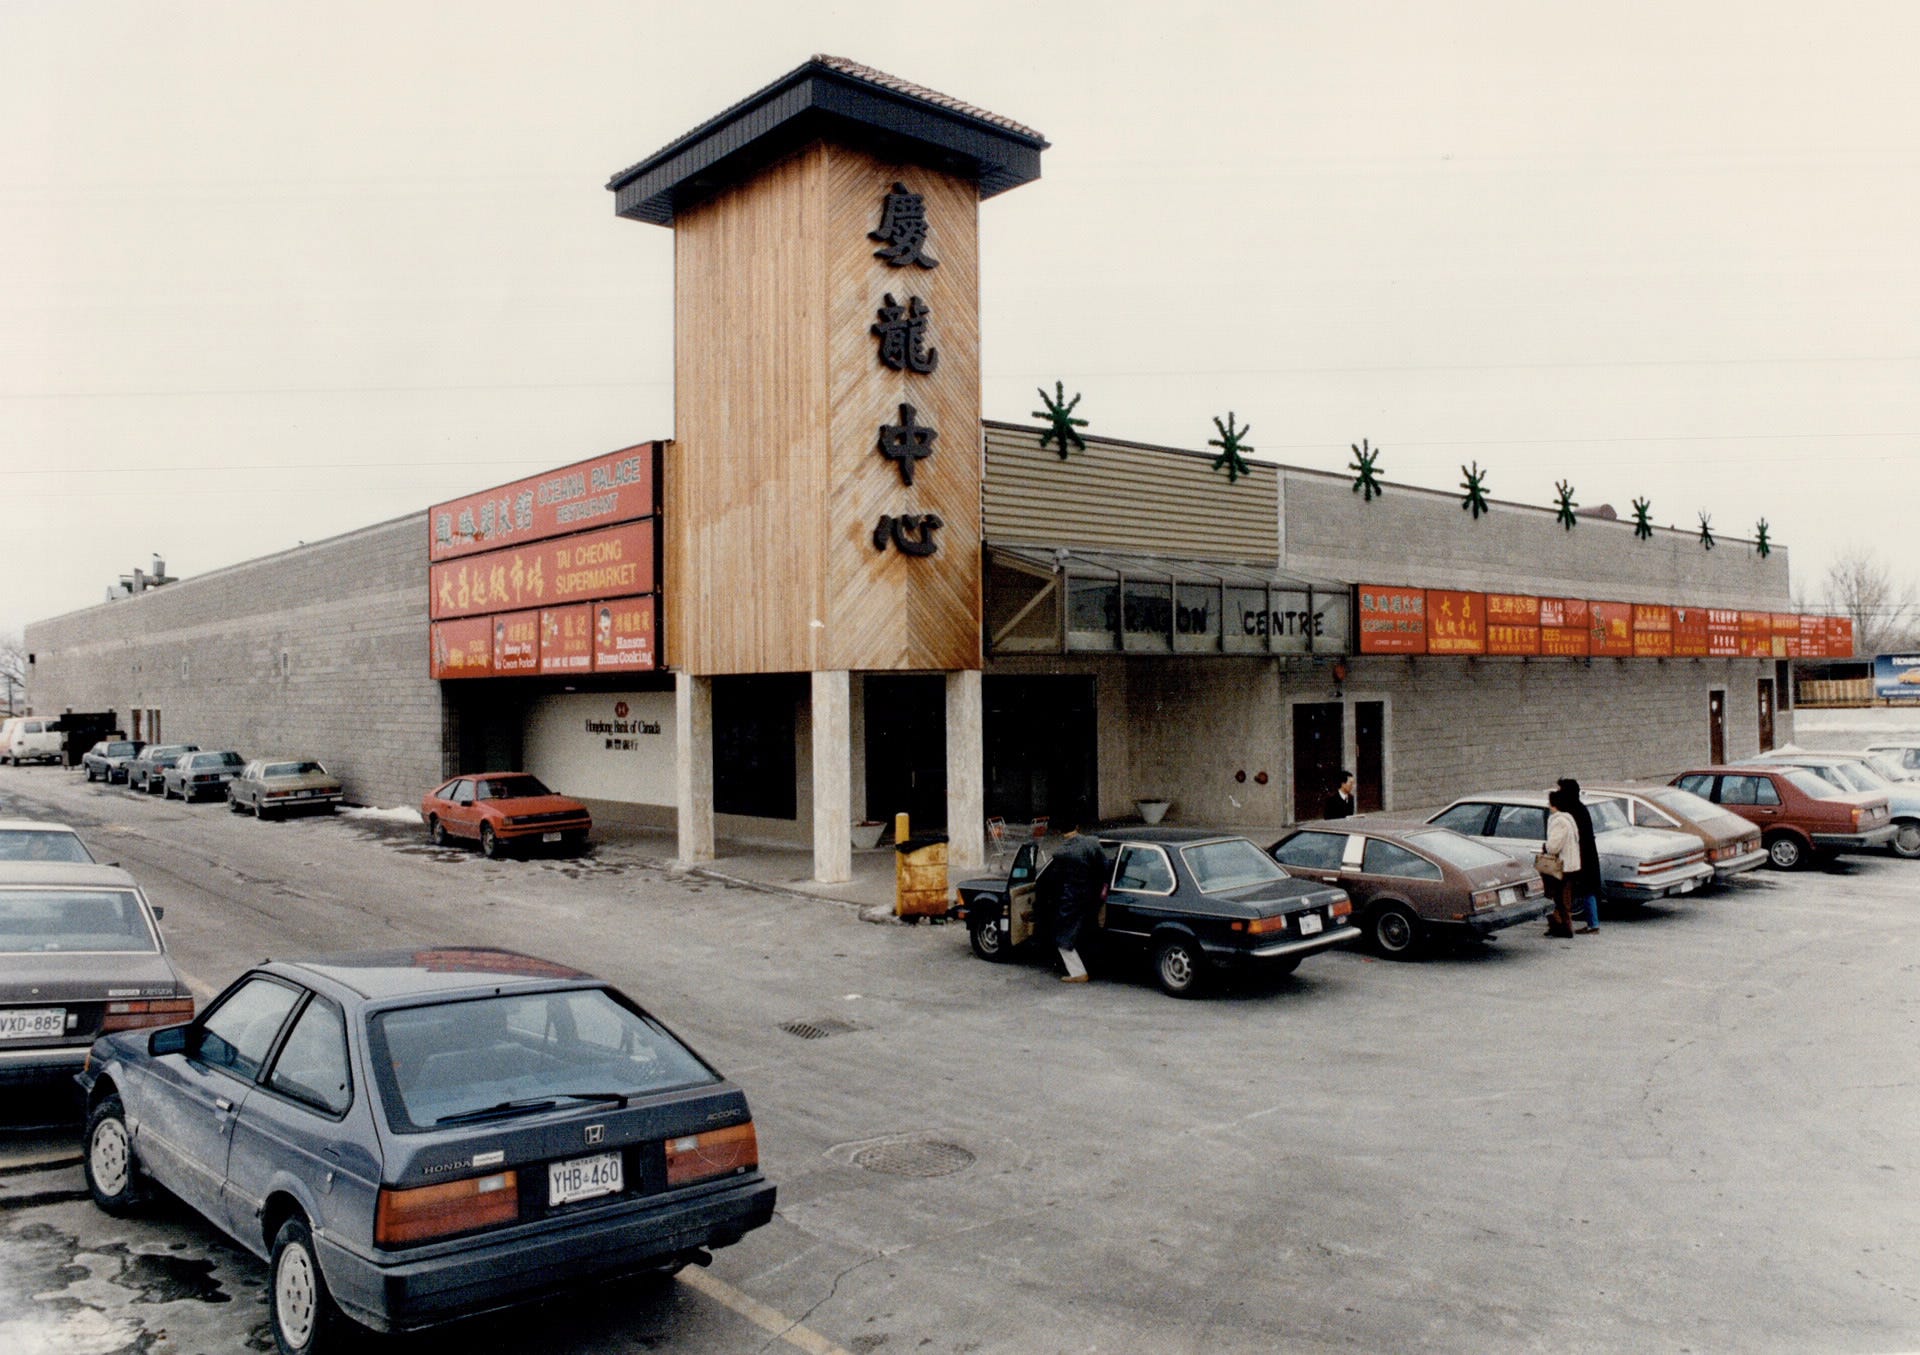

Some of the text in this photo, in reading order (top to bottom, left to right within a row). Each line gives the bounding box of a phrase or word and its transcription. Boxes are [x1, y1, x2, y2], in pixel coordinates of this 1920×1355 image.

[866, 181, 942, 557] 慶龍中心
[538, 457, 640, 504] OCEANA PALACE
[555, 493, 619, 525] RESTAURANT
[556, 539, 622, 569] TAI CHEONG
[555, 563, 637, 595] SUPERMARKET
[1243, 609, 1325, 636] CENTRE
[424, 1160, 471, 1174] HONDA
